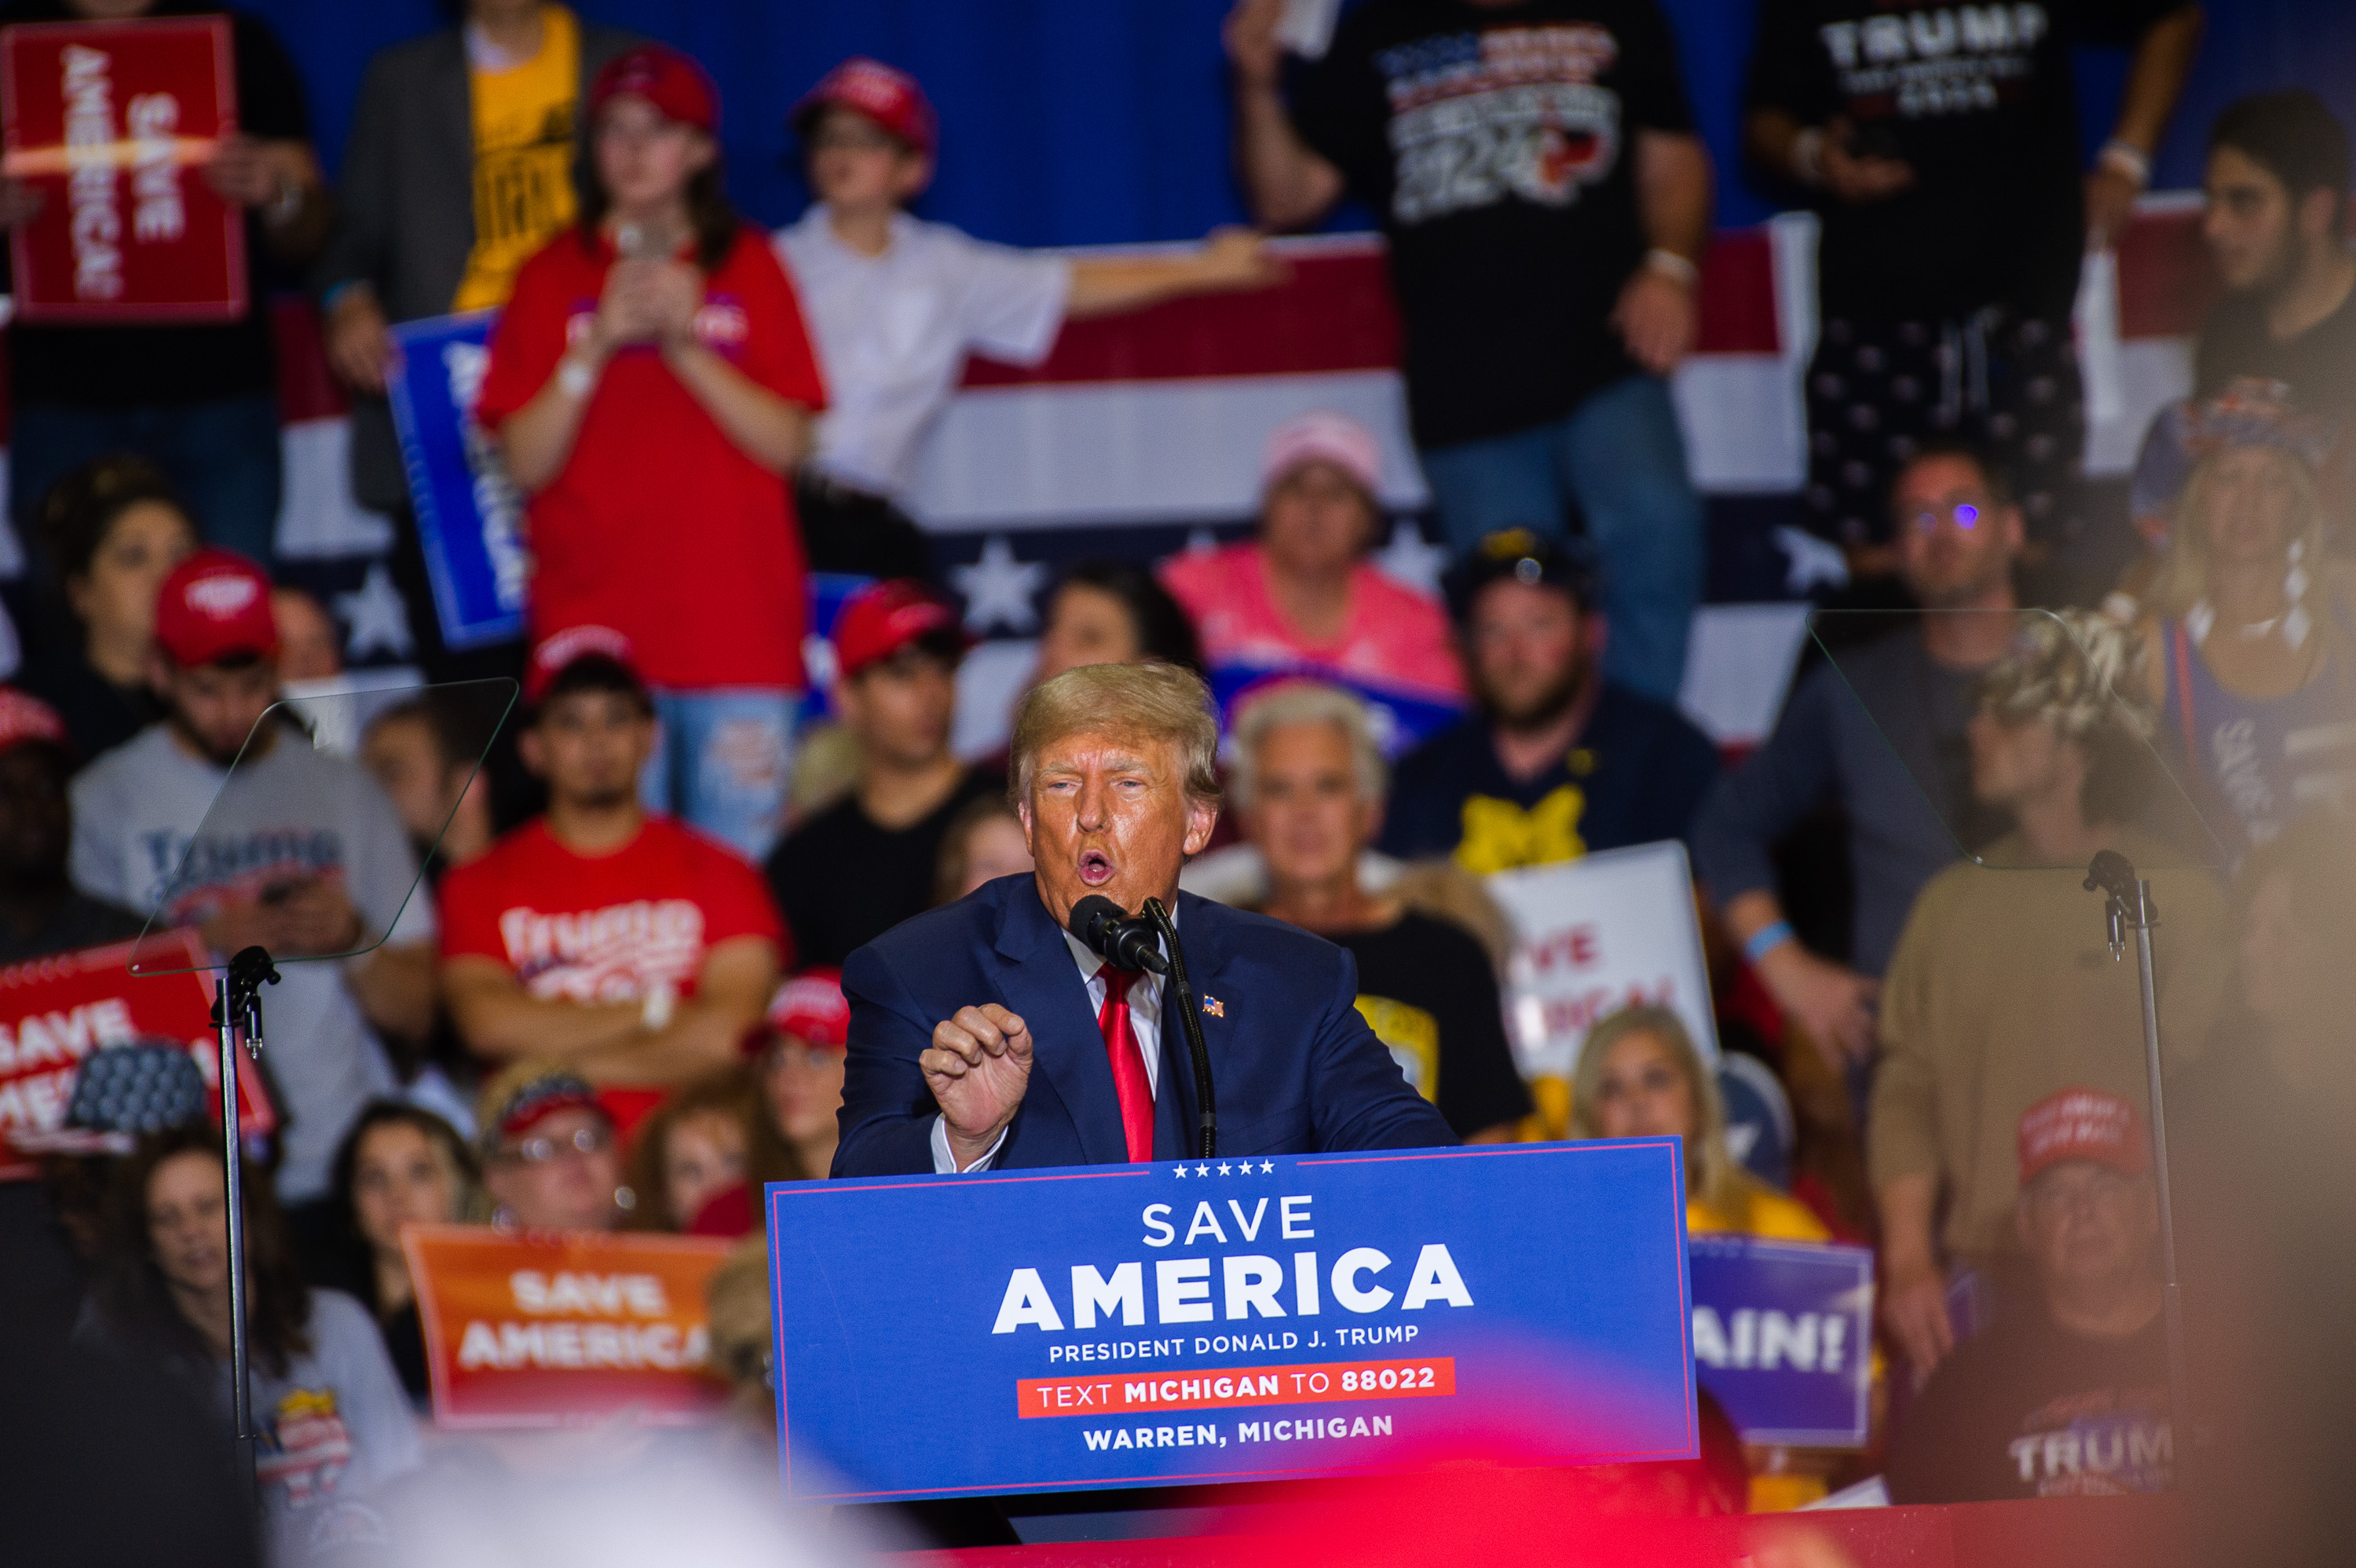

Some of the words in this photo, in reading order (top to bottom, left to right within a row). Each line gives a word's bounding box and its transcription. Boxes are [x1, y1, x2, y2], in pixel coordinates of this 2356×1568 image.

[1820, 3, 2049, 69] TRUMP
[127, 91, 185, 244] SAVE
[143, 826, 343, 884] Trump
[499, 899, 704, 966] Trump
[1516, 921, 1602, 976] VE
[1142, 1195, 1315, 1247] SAVE
[510, 1270, 667, 1318] SAVE
[992, 1244, 1474, 1334] AMERICA
[459, 1321, 710, 1370] AMERICA
[1049, 1338, 1185, 1363] PRESIDENT
[1194, 1332, 1298, 1354] DONALD
[1308, 1330, 1327, 1349] J.
[1335, 1325, 1419, 1347] TRUMP
[1693, 1306, 1846, 1373] AIN!
[1037, 1383, 1113, 1408] TEXT
[1124, 1374, 1279, 1403] MICHIGAN
[1290, 1371, 1330, 1394] TO
[1341, 1367, 1436, 1392] 88022
[1083, 1424, 1227, 1452] WARREN,
[1238, 1415, 1394, 1444] MICHIGAN
[2007, 1420, 2174, 1484] TRUM
